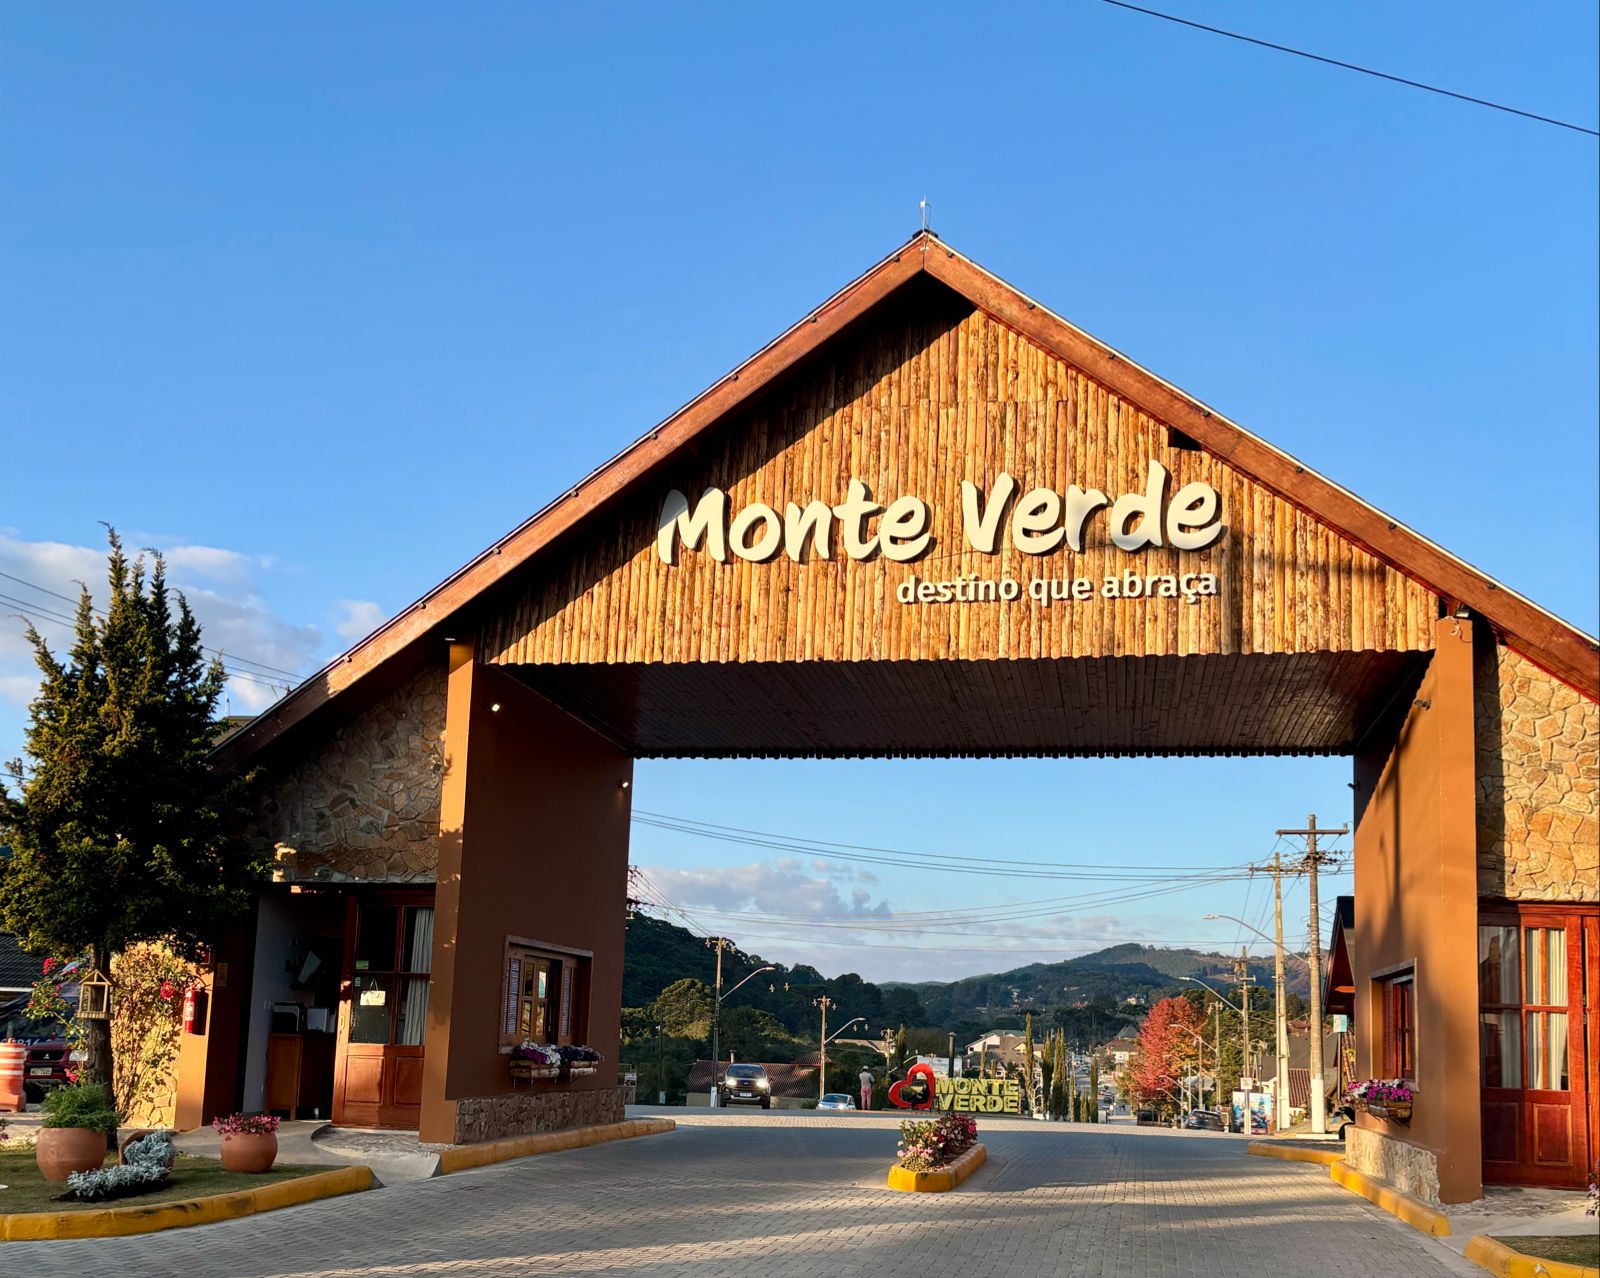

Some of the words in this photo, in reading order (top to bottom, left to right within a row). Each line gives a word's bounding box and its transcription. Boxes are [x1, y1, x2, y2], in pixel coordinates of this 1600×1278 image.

[657, 478, 930, 564] Monte
[962, 460, 1222, 554] Verde
[896, 574, 1018, 603] destino
[1029, 576, 1091, 608] que
[1101, 569, 1217, 603] abraça
[935, 1078, 1018, 1095] MONTE
[937, 1095, 1018, 1112] VERDE
